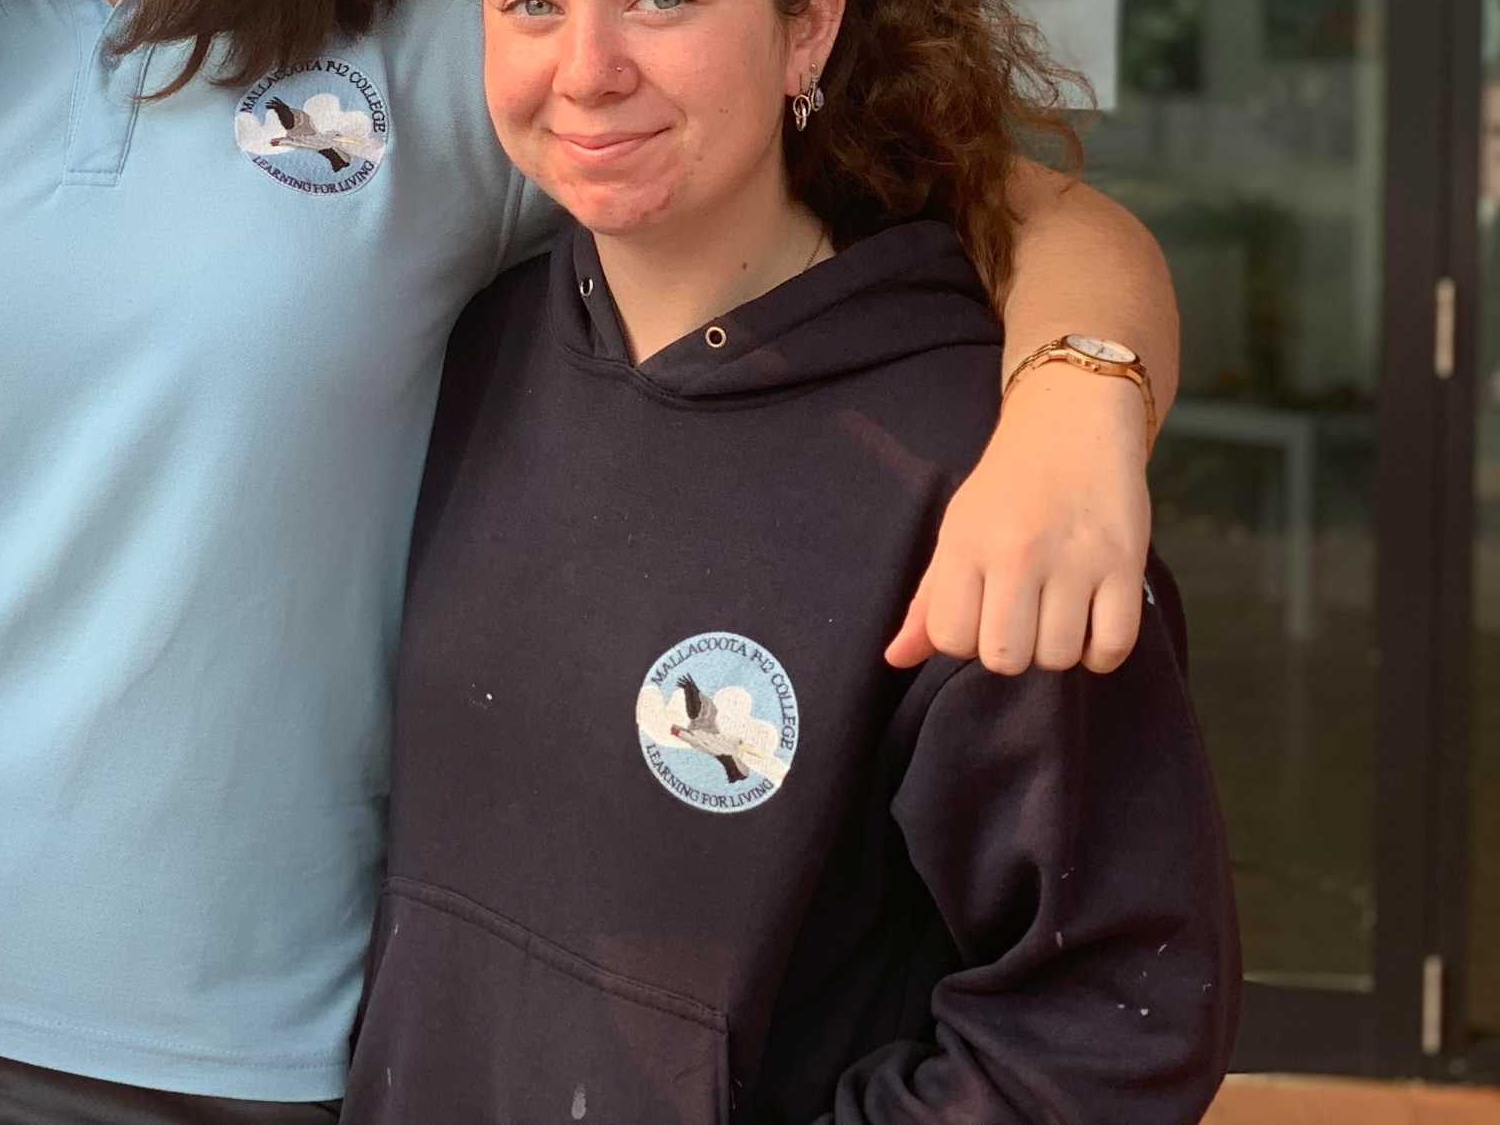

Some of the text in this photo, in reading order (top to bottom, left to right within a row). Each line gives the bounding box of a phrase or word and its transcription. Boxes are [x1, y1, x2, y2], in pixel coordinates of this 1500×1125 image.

[349, 71, 386, 133] COLLEGE
[252, 155, 375, 194] LEARNING FOR LIVING
[651, 637, 796, 751] MALLACOOTA P-12 COLLEGE
[645, 743, 775, 808] LEARNING FOR LIVING
